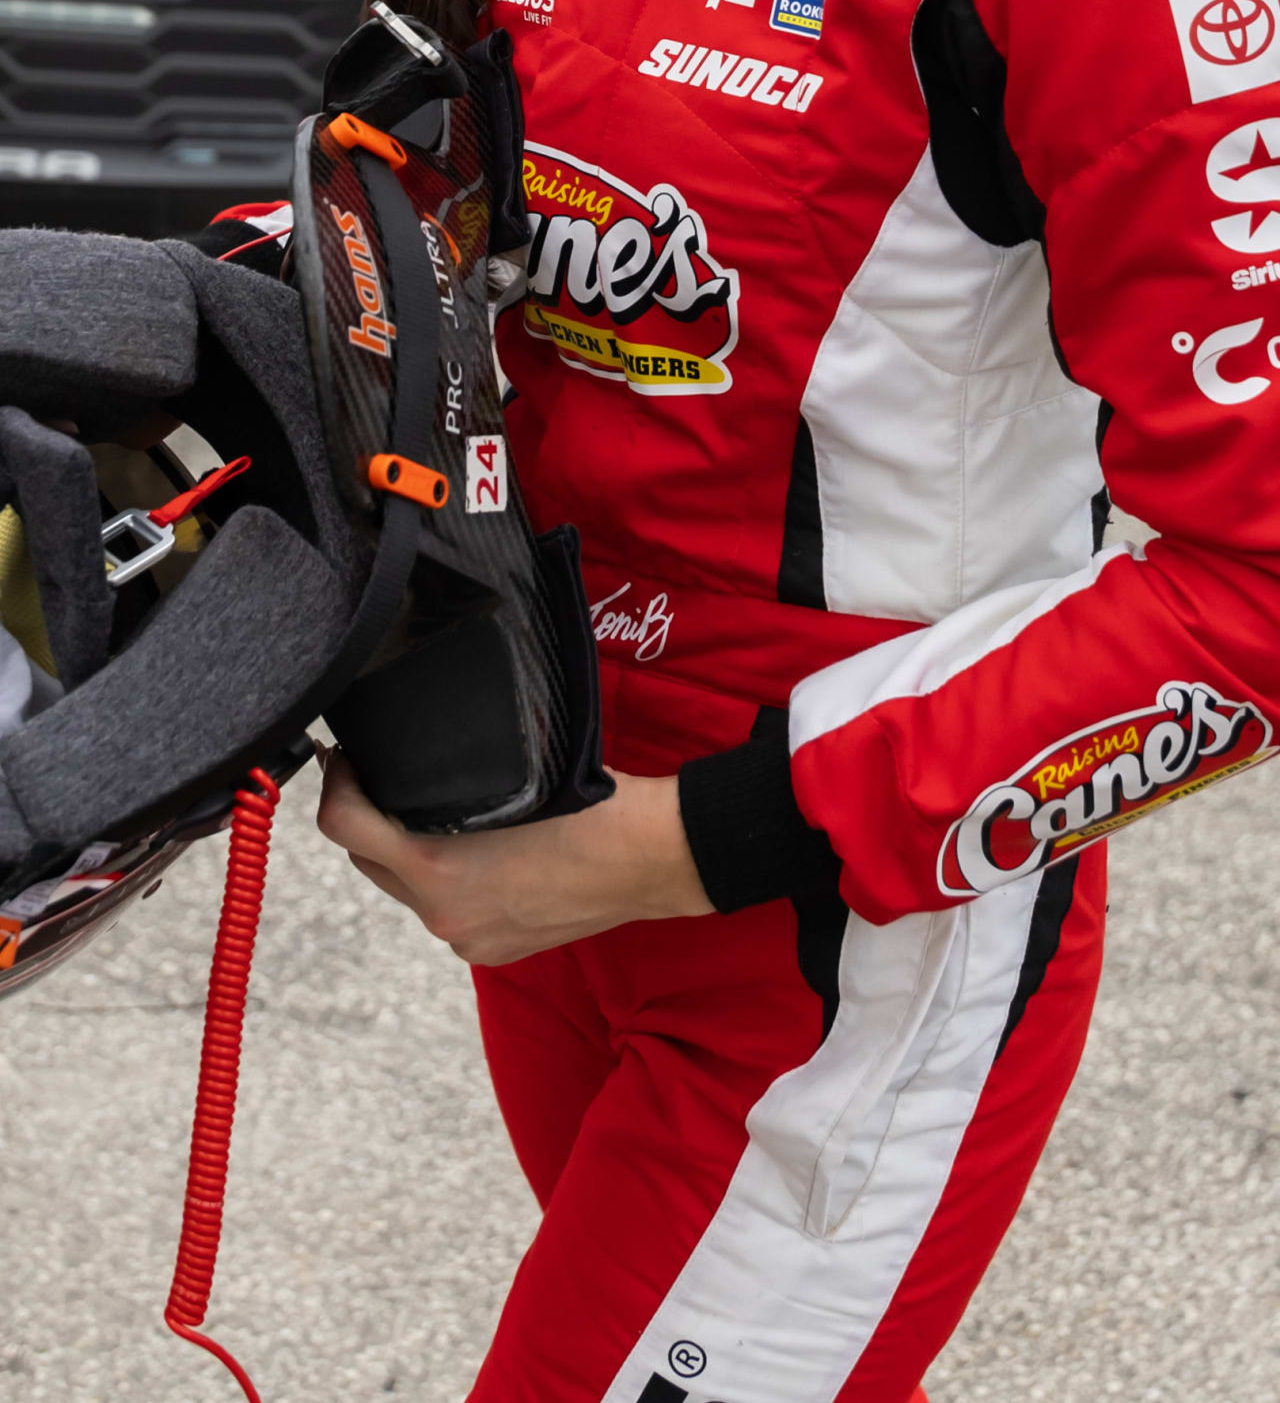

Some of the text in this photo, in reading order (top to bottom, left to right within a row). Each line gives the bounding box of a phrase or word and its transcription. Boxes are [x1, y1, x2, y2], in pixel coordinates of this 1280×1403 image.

[523, 10, 552, 26] LIVE FIT
[638, 37, 824, 114] SUNOCO
[522, 158, 614, 226] Raising
[329, 203, 397, 358] hans
[526, 191, 730, 315] ne's
[607, 338, 700, 380] FNGERS
[476, 439, 499, 506] 24
[955, 686, 1255, 894] Cane's
[1032, 725, 1140, 800] Raising
